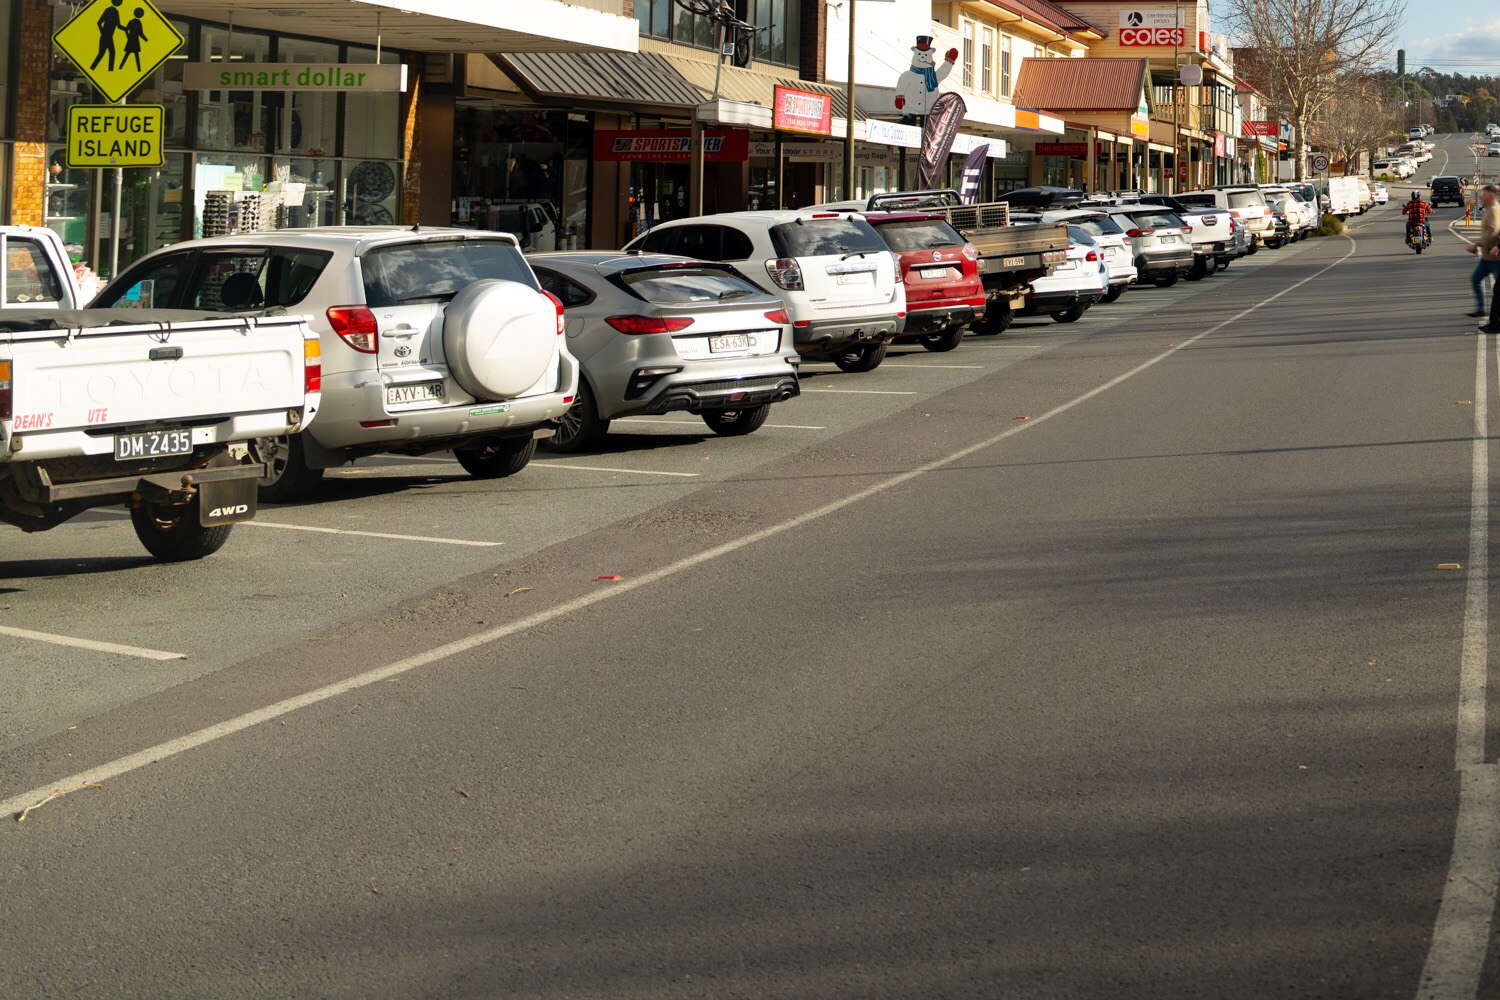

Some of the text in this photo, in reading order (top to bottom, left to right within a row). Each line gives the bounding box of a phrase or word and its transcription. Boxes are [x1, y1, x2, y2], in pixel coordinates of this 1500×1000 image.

[1120, 28, 1183, 45] coles
[219, 66, 367, 87] smart dollar
[77, 116, 154, 133] REFUGE
[78, 140, 151, 157] ISLAND
[871, 152, 887, 160] Bags
[1163, 166, 1187, 176] SAE
[1316, 159, 1325, 167] 50
[48, 360, 266, 407] TOYOTA
[14, 412, 54, 430] DEAN'S
[87, 408, 109, 423] UTE
[209, 503, 249, 518] 4WD
